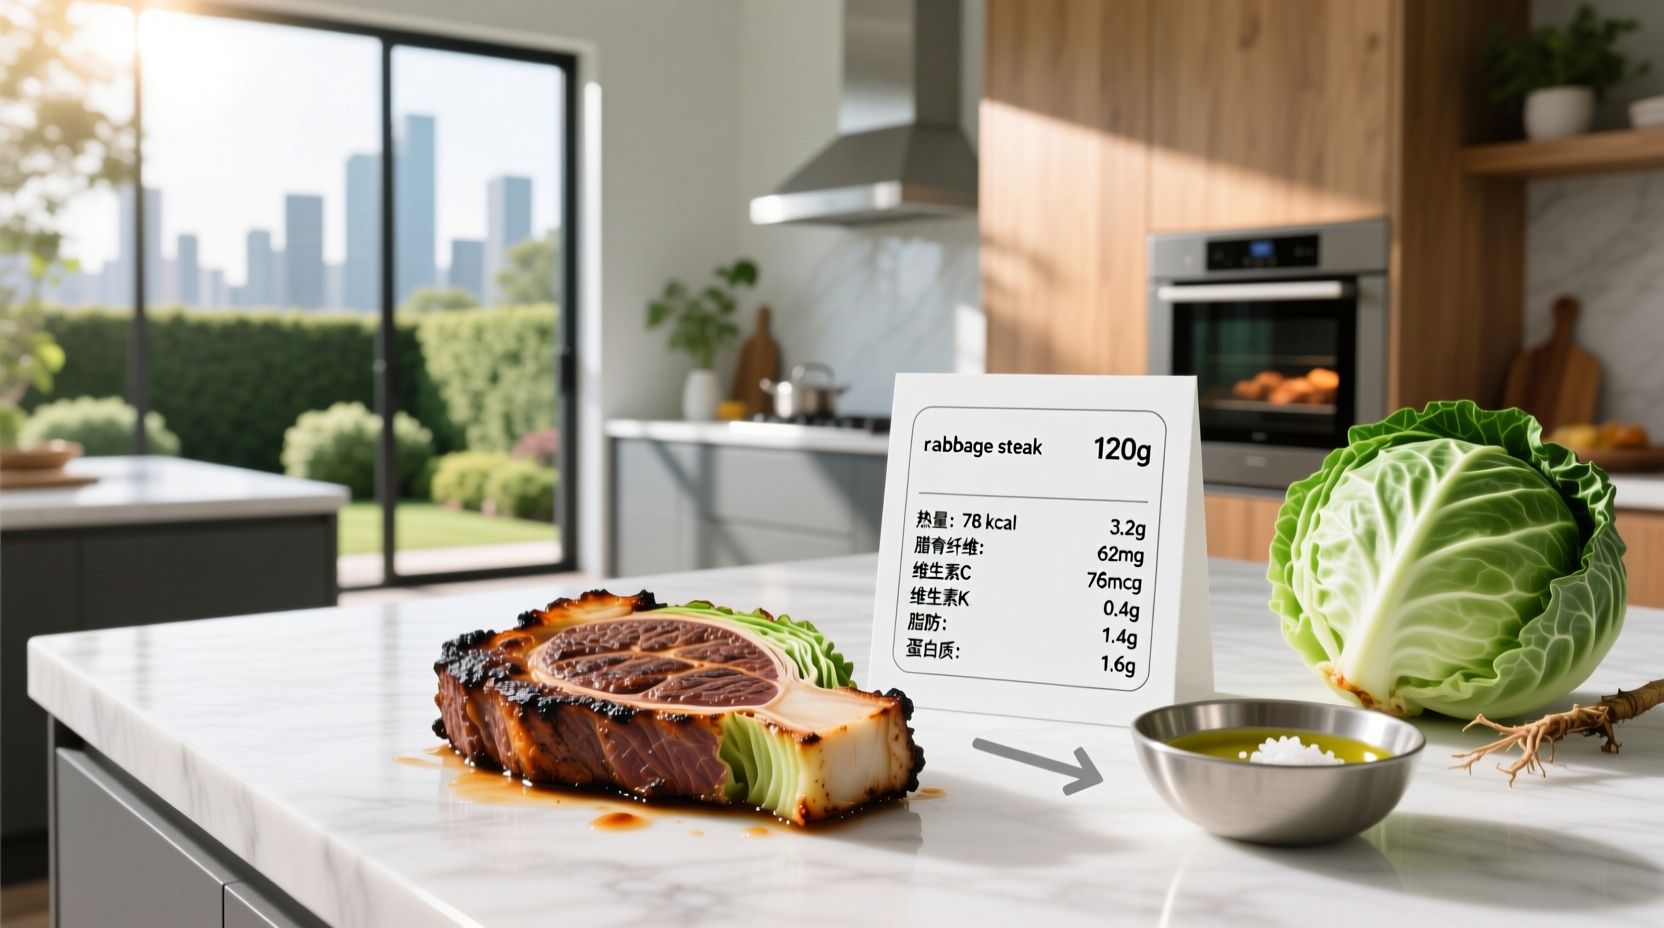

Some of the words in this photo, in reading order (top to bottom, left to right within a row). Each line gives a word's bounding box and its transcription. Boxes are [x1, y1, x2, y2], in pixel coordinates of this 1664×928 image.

[924, 436, 993, 457] rabbage
[998, 438, 1042, 455] steak
[1095, 437, 1151, 467] 120g
[963, 513, 981, 528] 78
[986, 513, 1016, 530] kcal
[1110, 519, 1146, 541] 3.2g
[1098, 546, 1144, 567] 62mg
[1087, 572, 1142, 595] 76mcg
[910, 587, 970, 606] 维生素K
[1104, 600, 1139, 622] 0.4g
[1103, 627, 1137, 649] 1.4g
[1102, 655, 1135, 678] 1.6g
